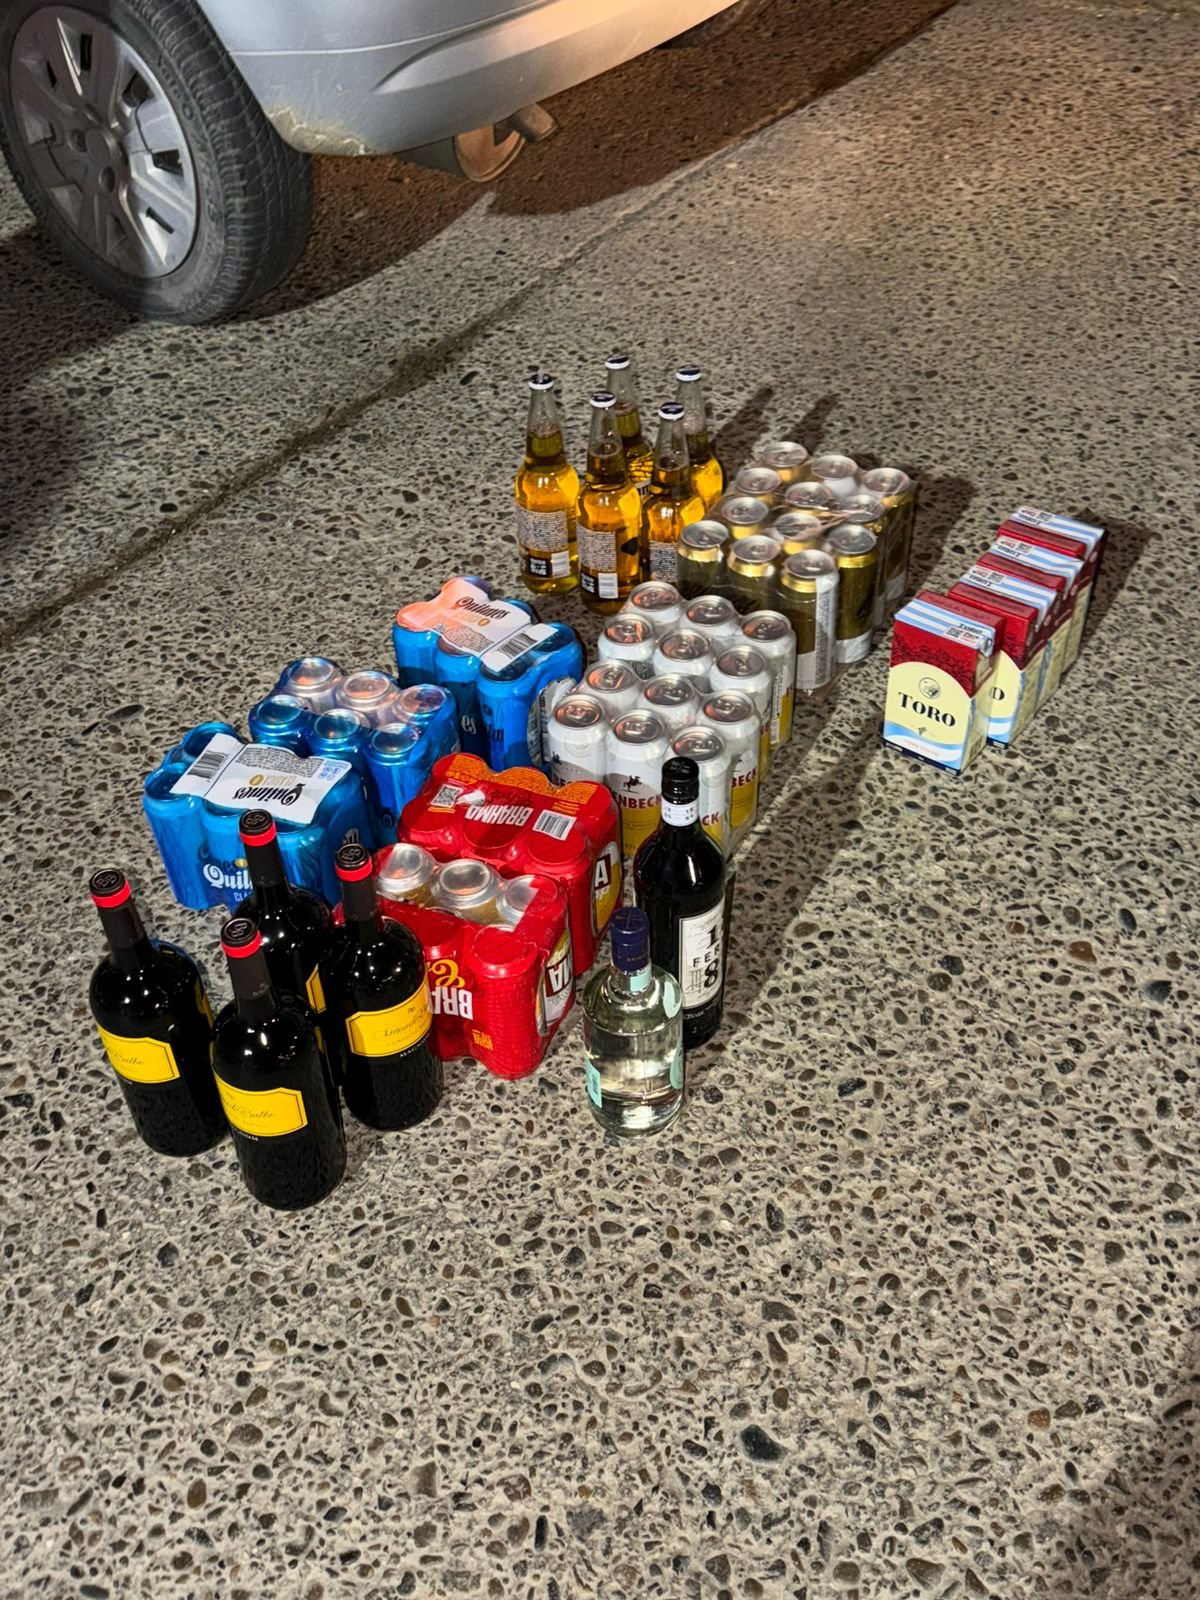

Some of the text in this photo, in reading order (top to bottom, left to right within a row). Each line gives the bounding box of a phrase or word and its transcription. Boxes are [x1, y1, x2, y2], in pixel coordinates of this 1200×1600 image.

[450, 596, 511, 620] Quilmes
[898, 691, 956, 727] TORO
[232, 783, 306, 806] Quilmes
[465, 804, 534, 827] BRAHMA
[203, 863, 254, 889] Quil
